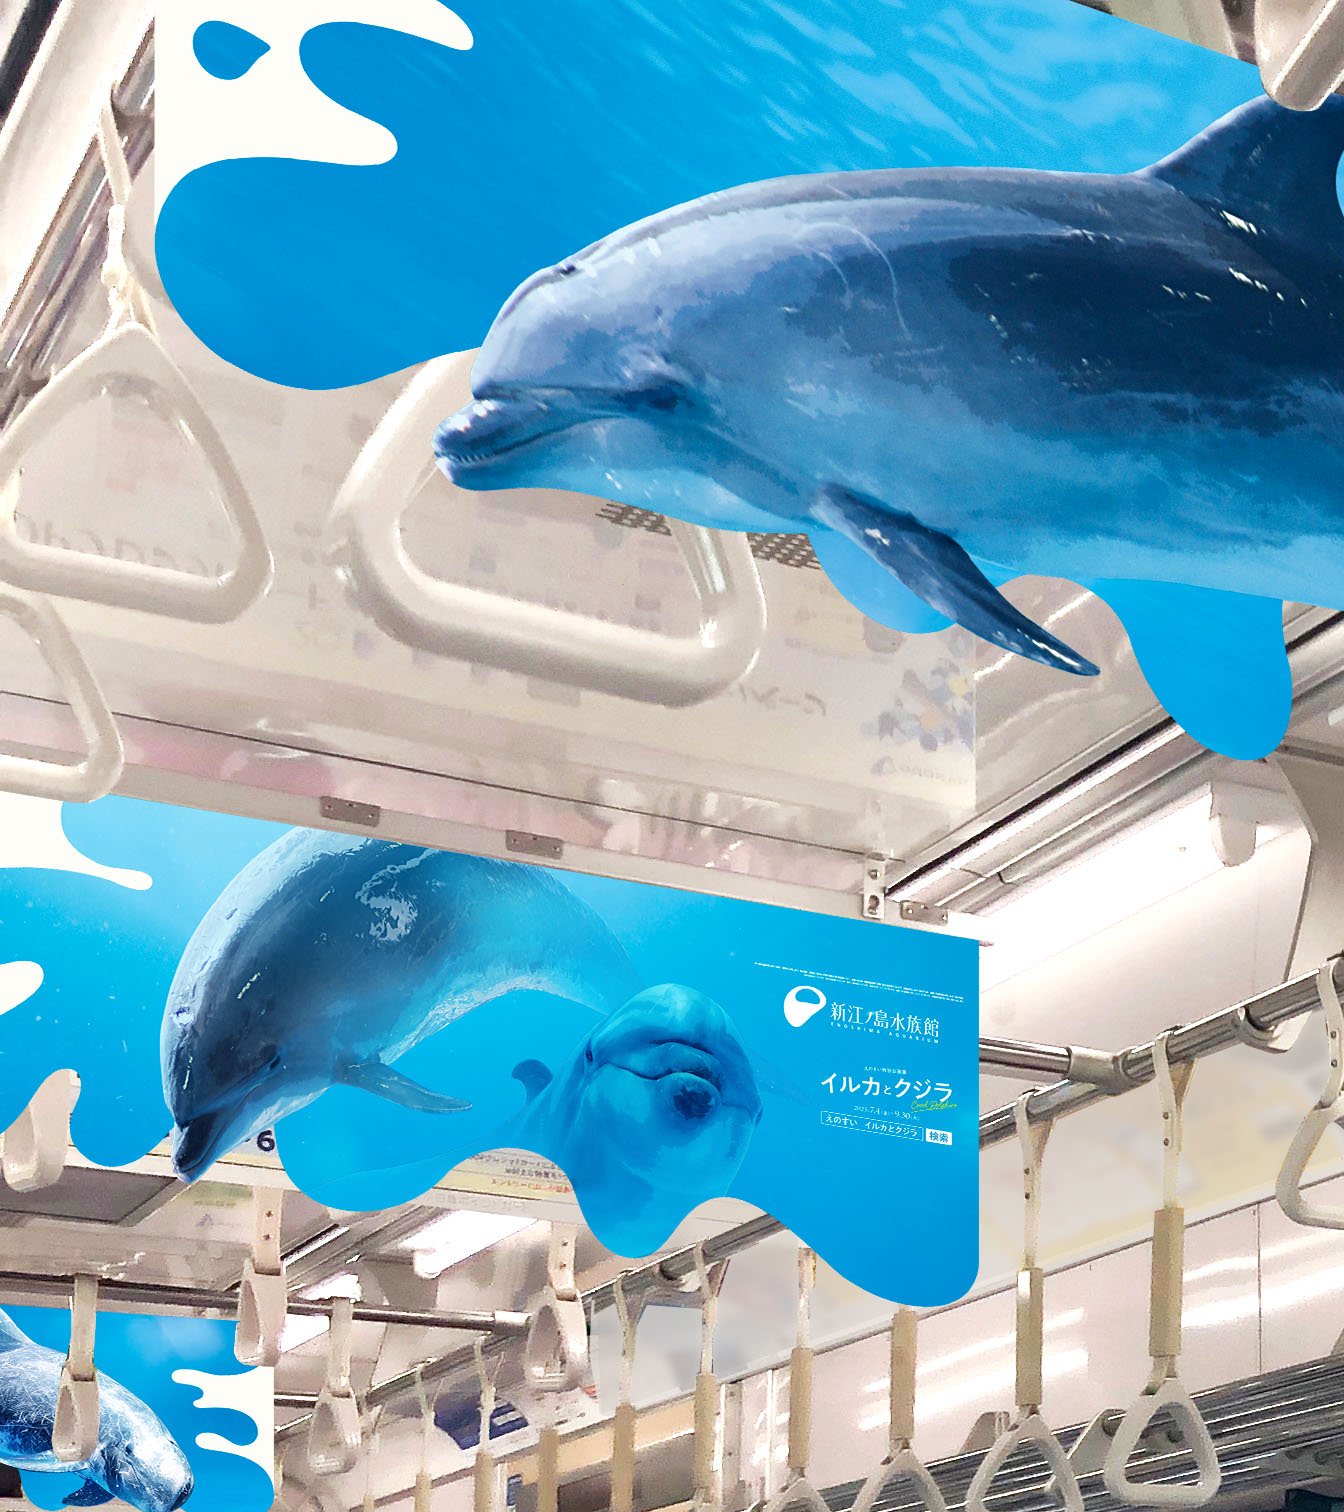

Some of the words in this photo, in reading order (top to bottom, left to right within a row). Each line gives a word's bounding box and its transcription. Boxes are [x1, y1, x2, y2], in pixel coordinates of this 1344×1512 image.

[830, 1001, 939, 1038] 新江ノ島水族館
[821, 1072, 953, 1103] イルカとクジラ
[257, 1130, 275, 1152] 6
[826, 1114, 858, 1126] えのすい
[864, 1121, 918, 1137] イルカとクジラ
[929, 1131, 949, 1143] 検索
